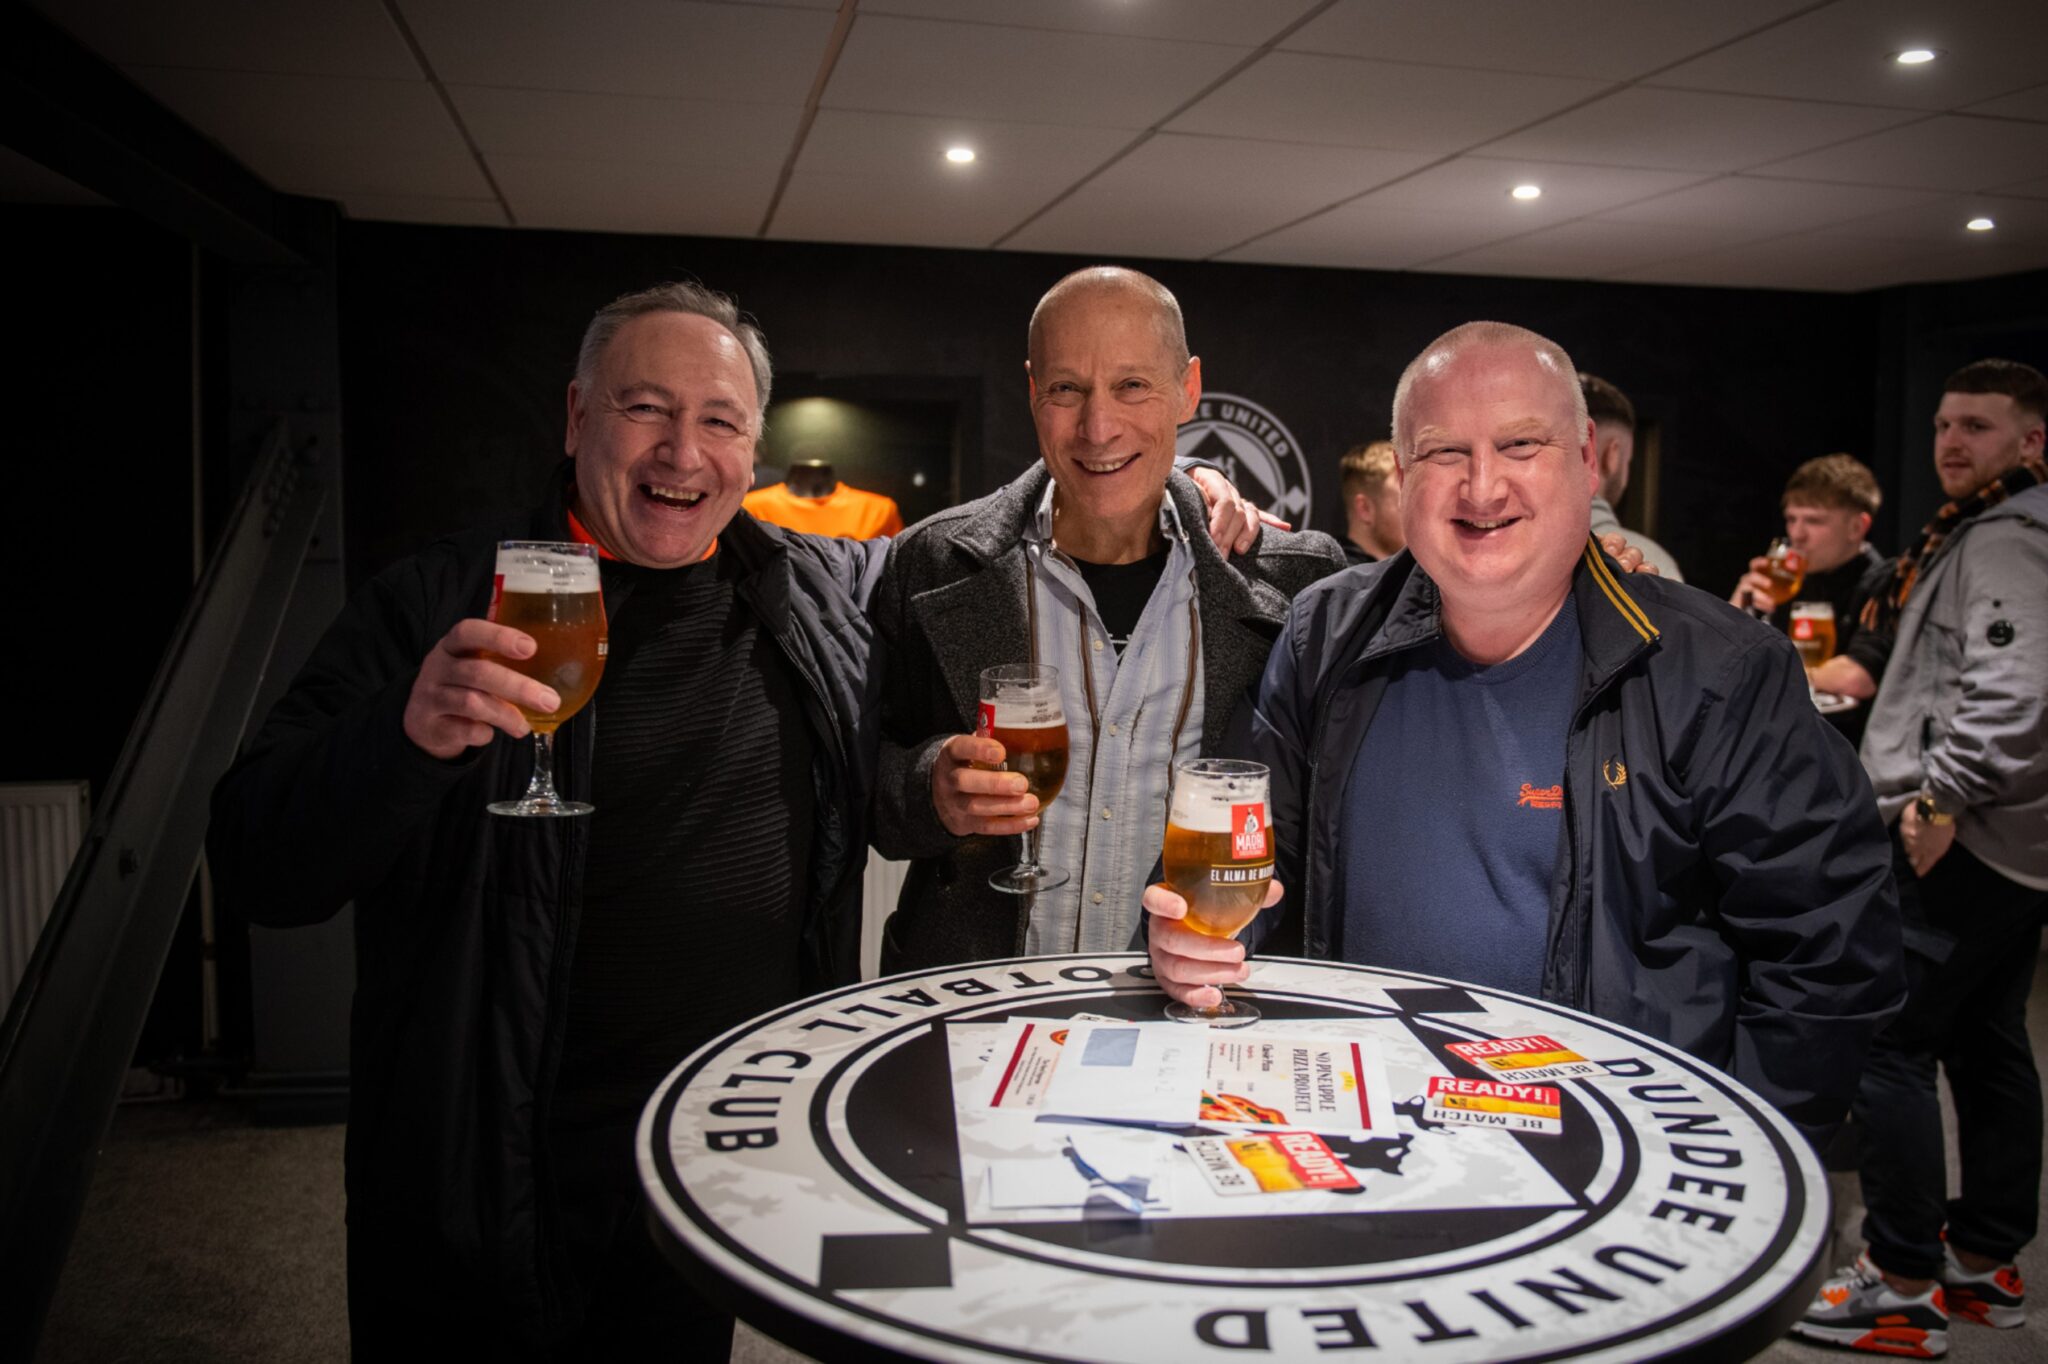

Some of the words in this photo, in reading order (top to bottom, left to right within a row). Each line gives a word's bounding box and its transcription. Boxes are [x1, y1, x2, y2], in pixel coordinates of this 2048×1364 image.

[1220, 403, 1290, 457] UNITED
[1210, 869, 1220, 881] EL
[1223, 870, 1246, 882] ALMA
[1315, 1051, 1331, 1062] NO
[1455, 1037, 1547, 1057] READY!
[1293, 1048, 1309, 1071] PIZZA
[1567, 1064, 1592, 1075] BE
[1500, 1068, 1566, 1082] MATCH
[1294, 1073, 1311, 1113] PROJECT
[1316, 1063, 1336, 1112] PINEAPPLE
[1437, 1078, 1542, 1101] READY!
[705, 1049, 813, 1153] CLUB
[1433, 1110, 1506, 1126] MATCH
[1516, 1118, 1543, 1129] BE
[1277, 1133, 1349, 1182] READY!
[1604, 1057, 1746, 1235] DUNDEE
[1194, 1245, 1686, 1353] UNITED
